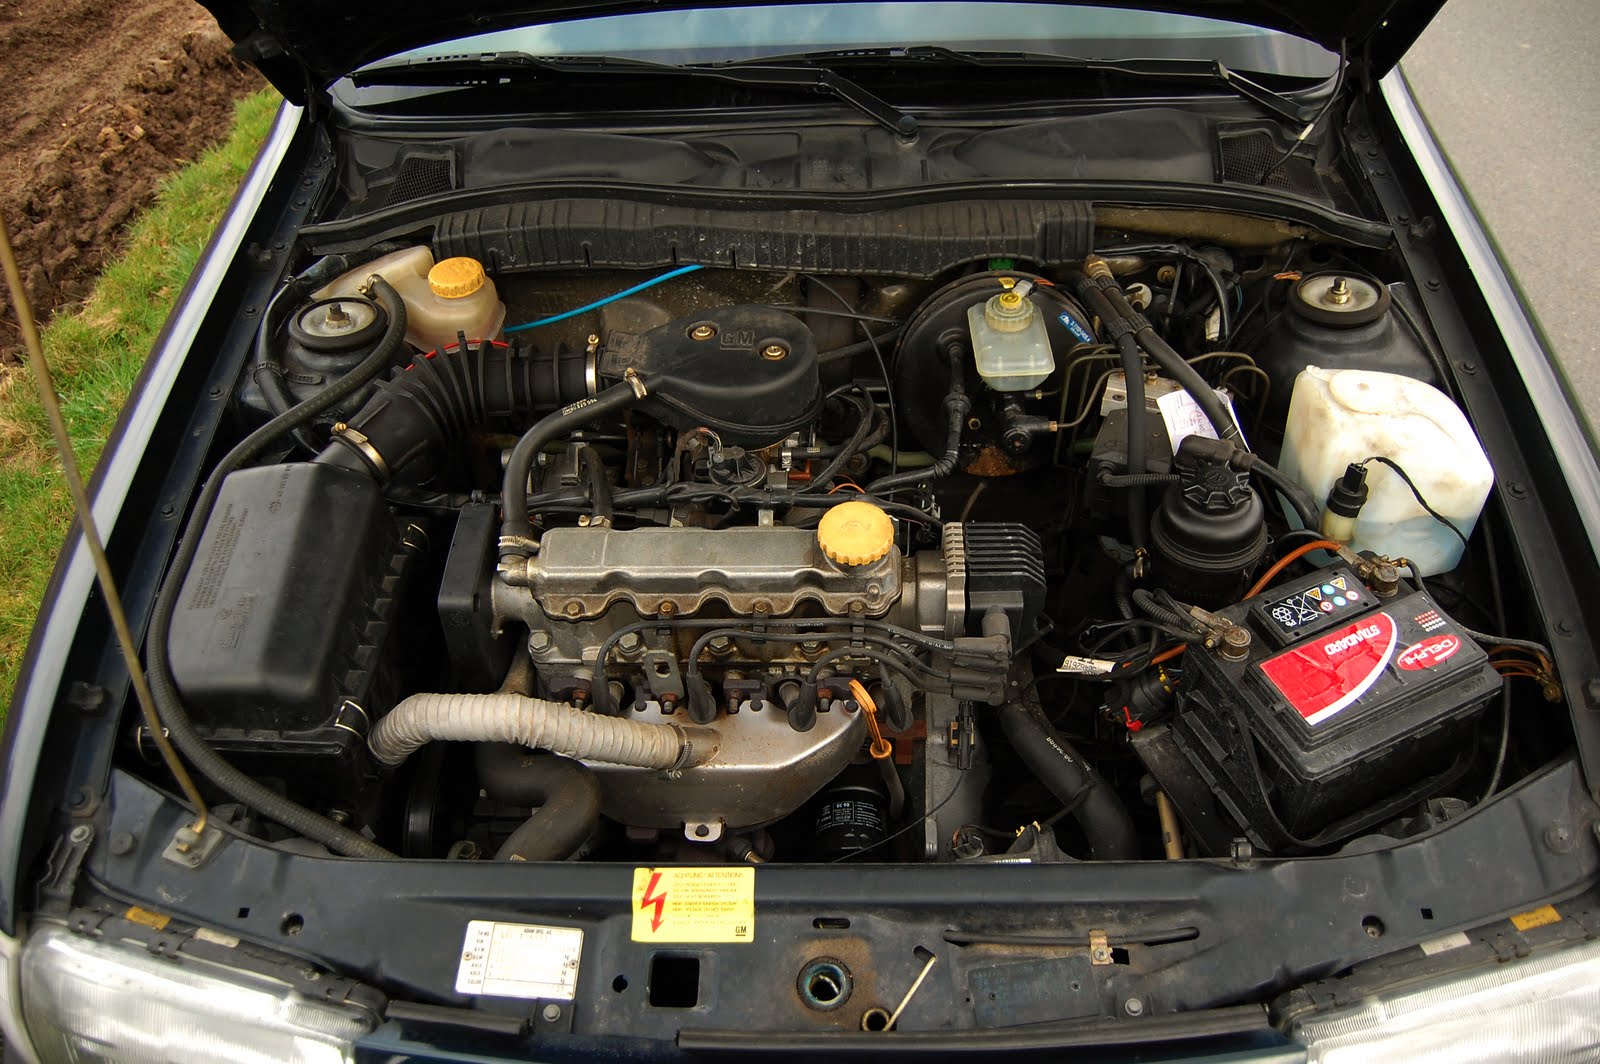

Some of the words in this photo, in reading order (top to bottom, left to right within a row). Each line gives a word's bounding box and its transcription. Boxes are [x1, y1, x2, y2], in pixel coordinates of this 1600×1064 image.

[720, 330, 755, 346] GM
[1324, 624, 1381, 656] STANDARD
[1403, 639, 1454, 665] DELPHI
